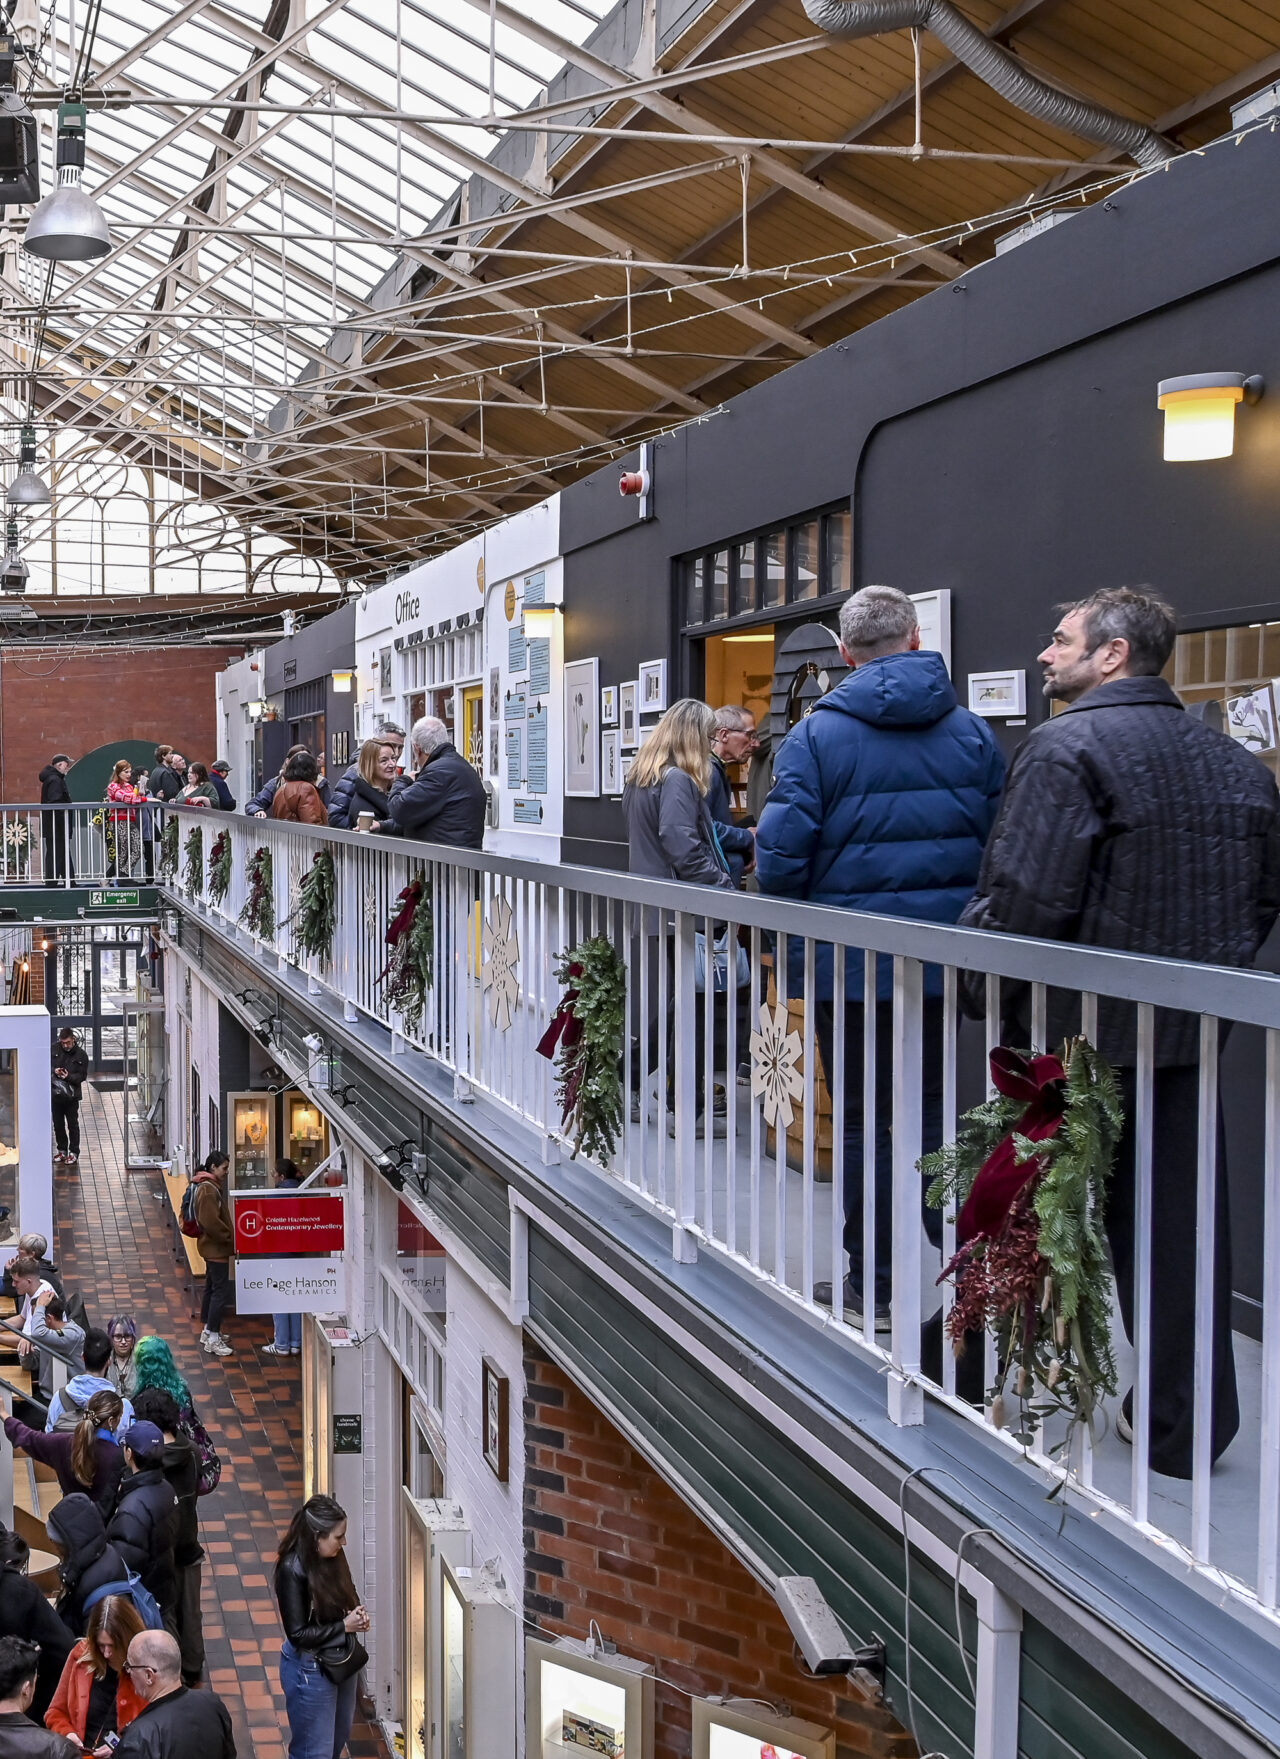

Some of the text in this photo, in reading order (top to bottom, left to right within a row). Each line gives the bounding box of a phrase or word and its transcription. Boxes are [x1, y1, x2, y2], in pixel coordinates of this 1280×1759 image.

[395, 590, 420, 625] Office
[243, 1276, 337, 1292] Lee Page Hanson
[285, 1288, 337, 1296] CERAMICS
